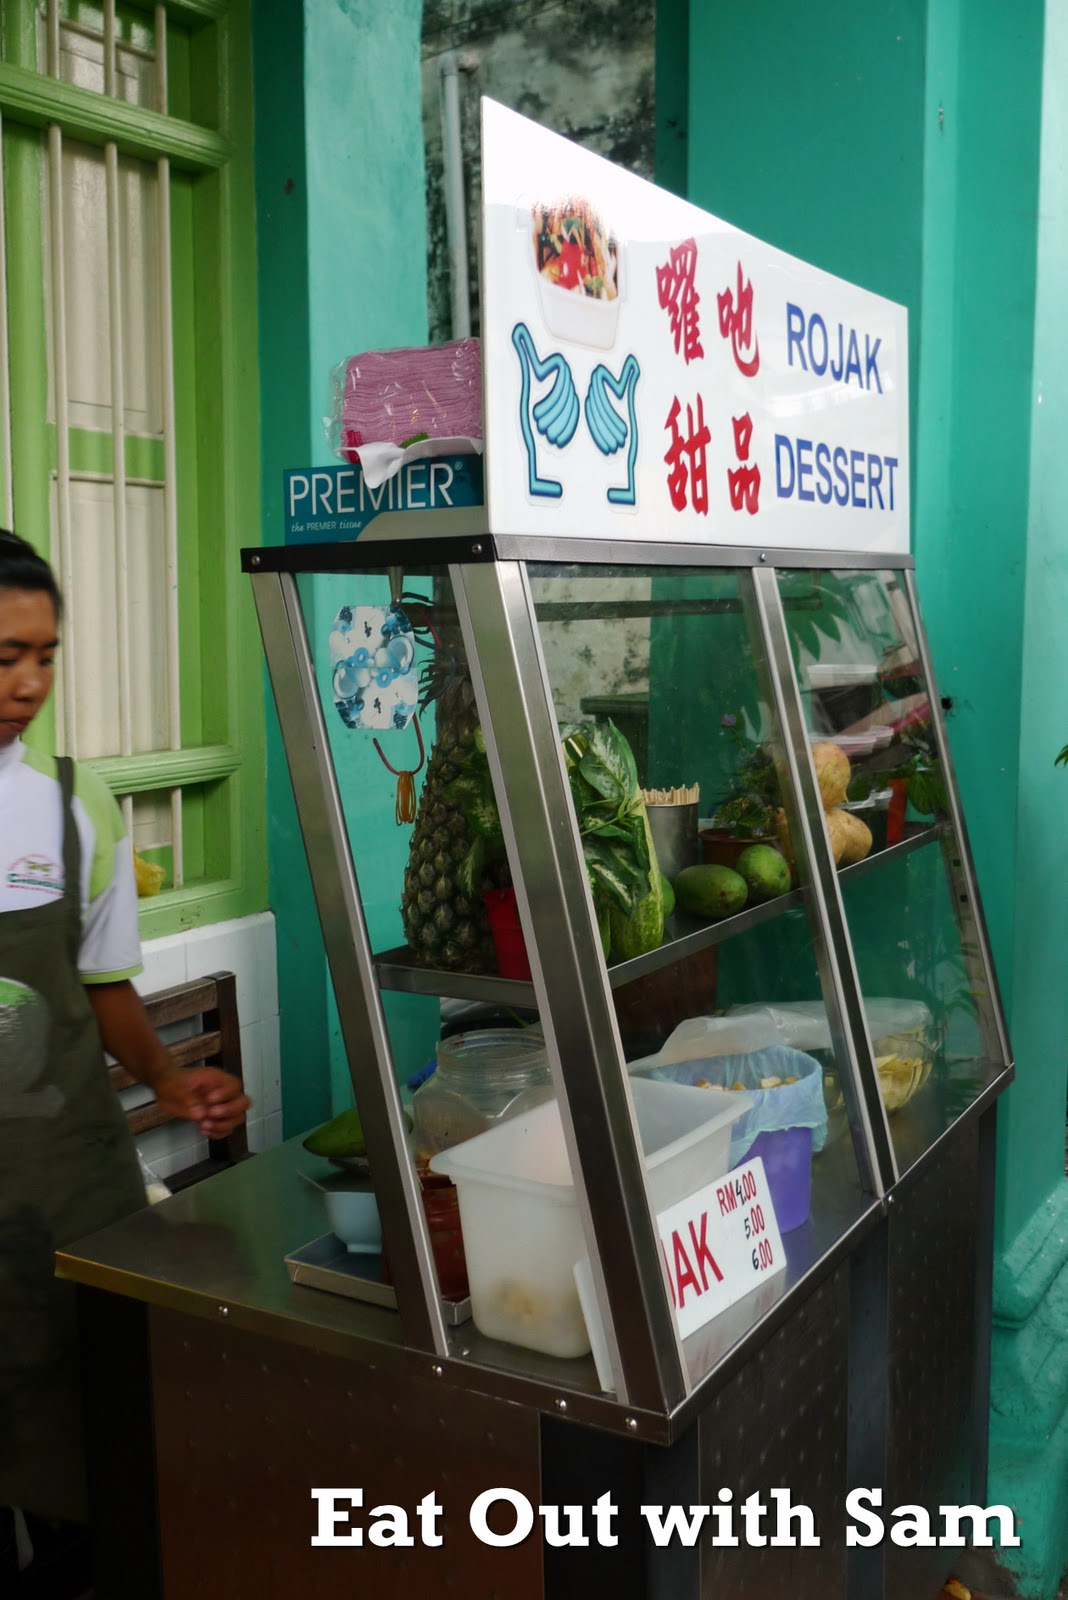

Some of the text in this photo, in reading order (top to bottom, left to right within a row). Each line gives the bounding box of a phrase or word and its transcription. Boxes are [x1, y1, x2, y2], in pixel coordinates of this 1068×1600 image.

[786, 302, 883, 394] ROJAK
[663, 393, 761, 516] 甜品
[774, 434, 899, 510] DESSERT
[290, 463, 454, 517] PREMIER
[291, 519, 363, 533] the PREMIER tissue
[716, 1170, 757, 1216] RM4.00
[744, 1204, 765, 1240] 5.00
[752, 1238, 773, 1271] 6.00
